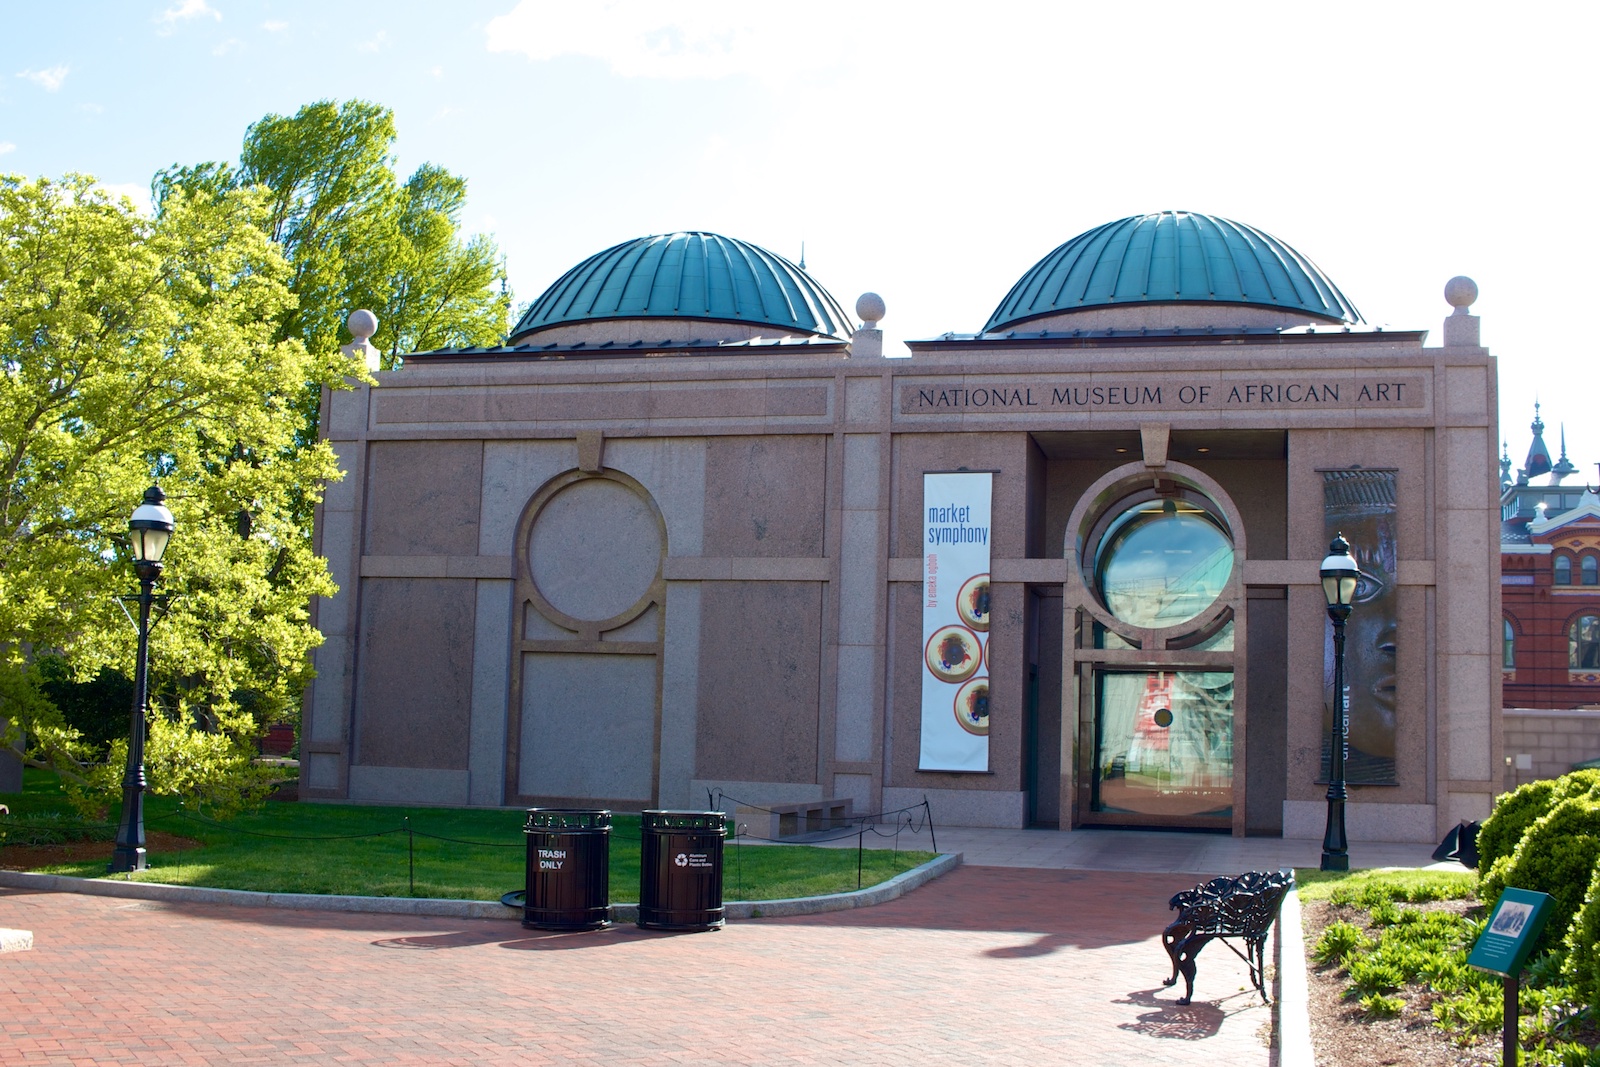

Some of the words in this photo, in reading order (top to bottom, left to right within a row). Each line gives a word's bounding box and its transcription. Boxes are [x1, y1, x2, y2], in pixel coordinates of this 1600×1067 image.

[919, 388, 1038, 407] NATIONAL
[1051, 386, 1162, 405] MUSEUM
[1178, 385, 1211, 404] OF
[1227, 384, 1339, 403] AFRICAN
[1358, 383, 1407, 402] ART
[928, 503, 970, 523] market
[928, 523, 988, 546] symphony
[926, 599, 938, 608] by
[538, 849, 567, 859] TRASH
[539, 860, 563, 870] ONLY
